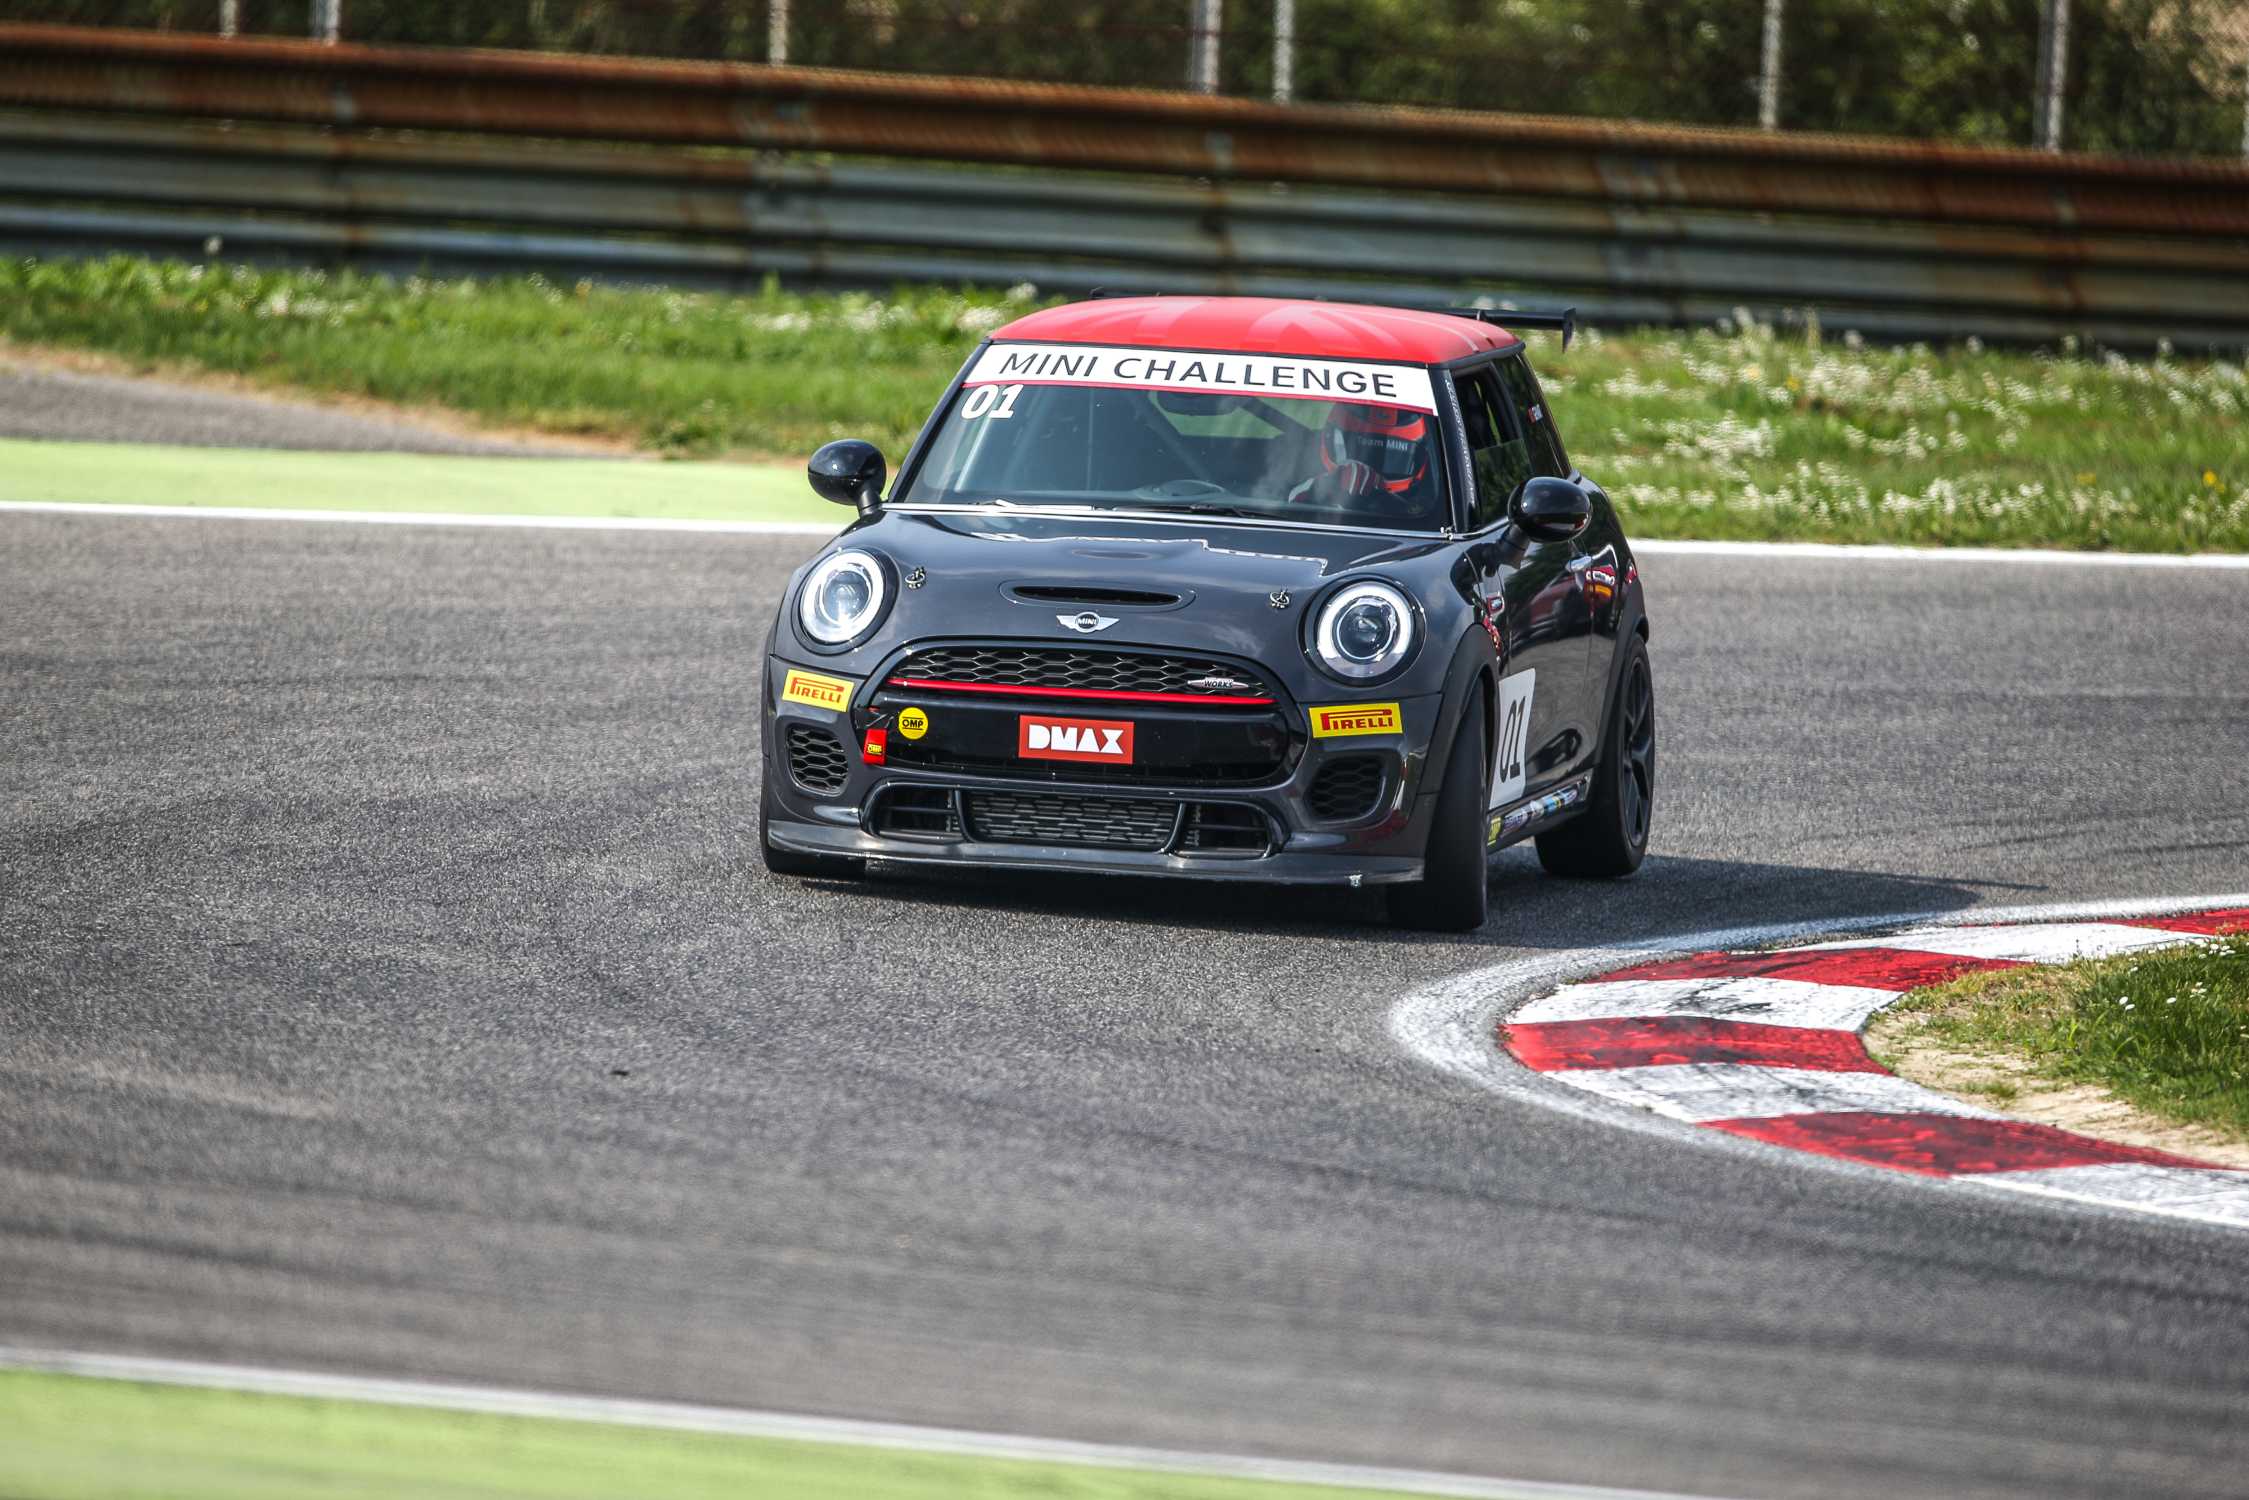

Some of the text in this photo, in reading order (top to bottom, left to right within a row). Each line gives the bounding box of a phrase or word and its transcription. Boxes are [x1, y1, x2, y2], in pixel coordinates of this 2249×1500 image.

[998, 352, 1397, 398] MINI CHALLENGE
[961, 384, 1024, 419] 01
[1077, 617, 1098, 625] MINI
[789, 677, 845, 704] PIRELLI
[1204, 680, 1233, 689] WORKS
[902, 719, 924, 729] OMP
[1320, 709, 1393, 731] PIRELLI
[1028, 724, 1124, 755] DMAX
[1500, 696, 1527, 784] 01
